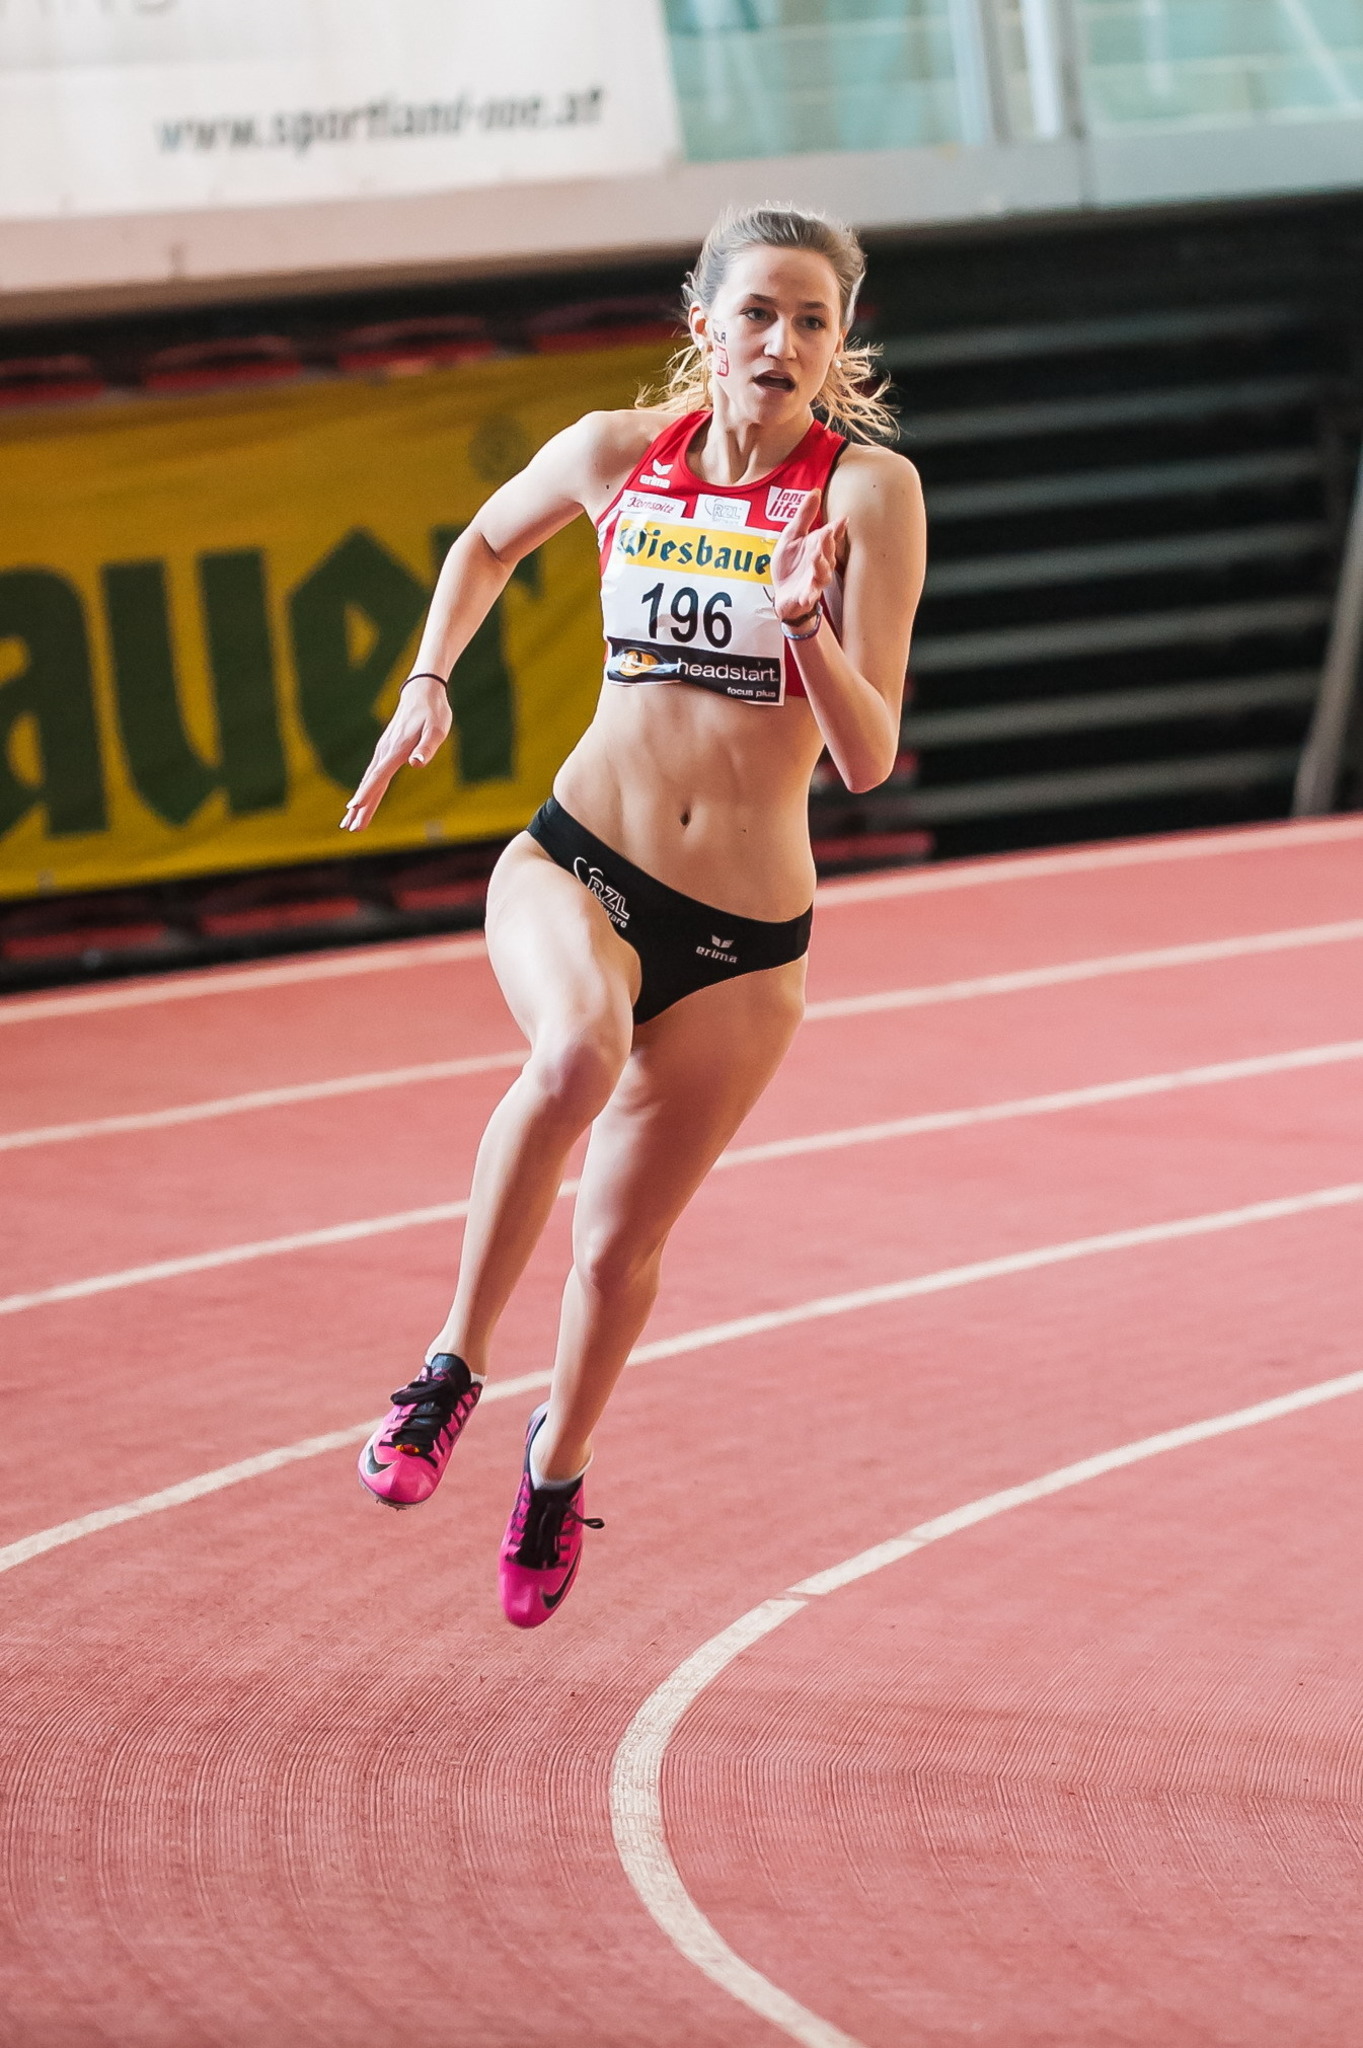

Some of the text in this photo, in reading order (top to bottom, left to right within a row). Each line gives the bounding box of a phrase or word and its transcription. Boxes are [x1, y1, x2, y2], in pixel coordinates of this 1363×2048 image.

[767, 500, 798, 519] life
[641, 582, 733, 649] 196
[676, 657, 776, 682] headstart
[727, 686, 776, 699] focus plus
[587, 875, 631, 920] RZL
[695, 945, 738, 964] erima
